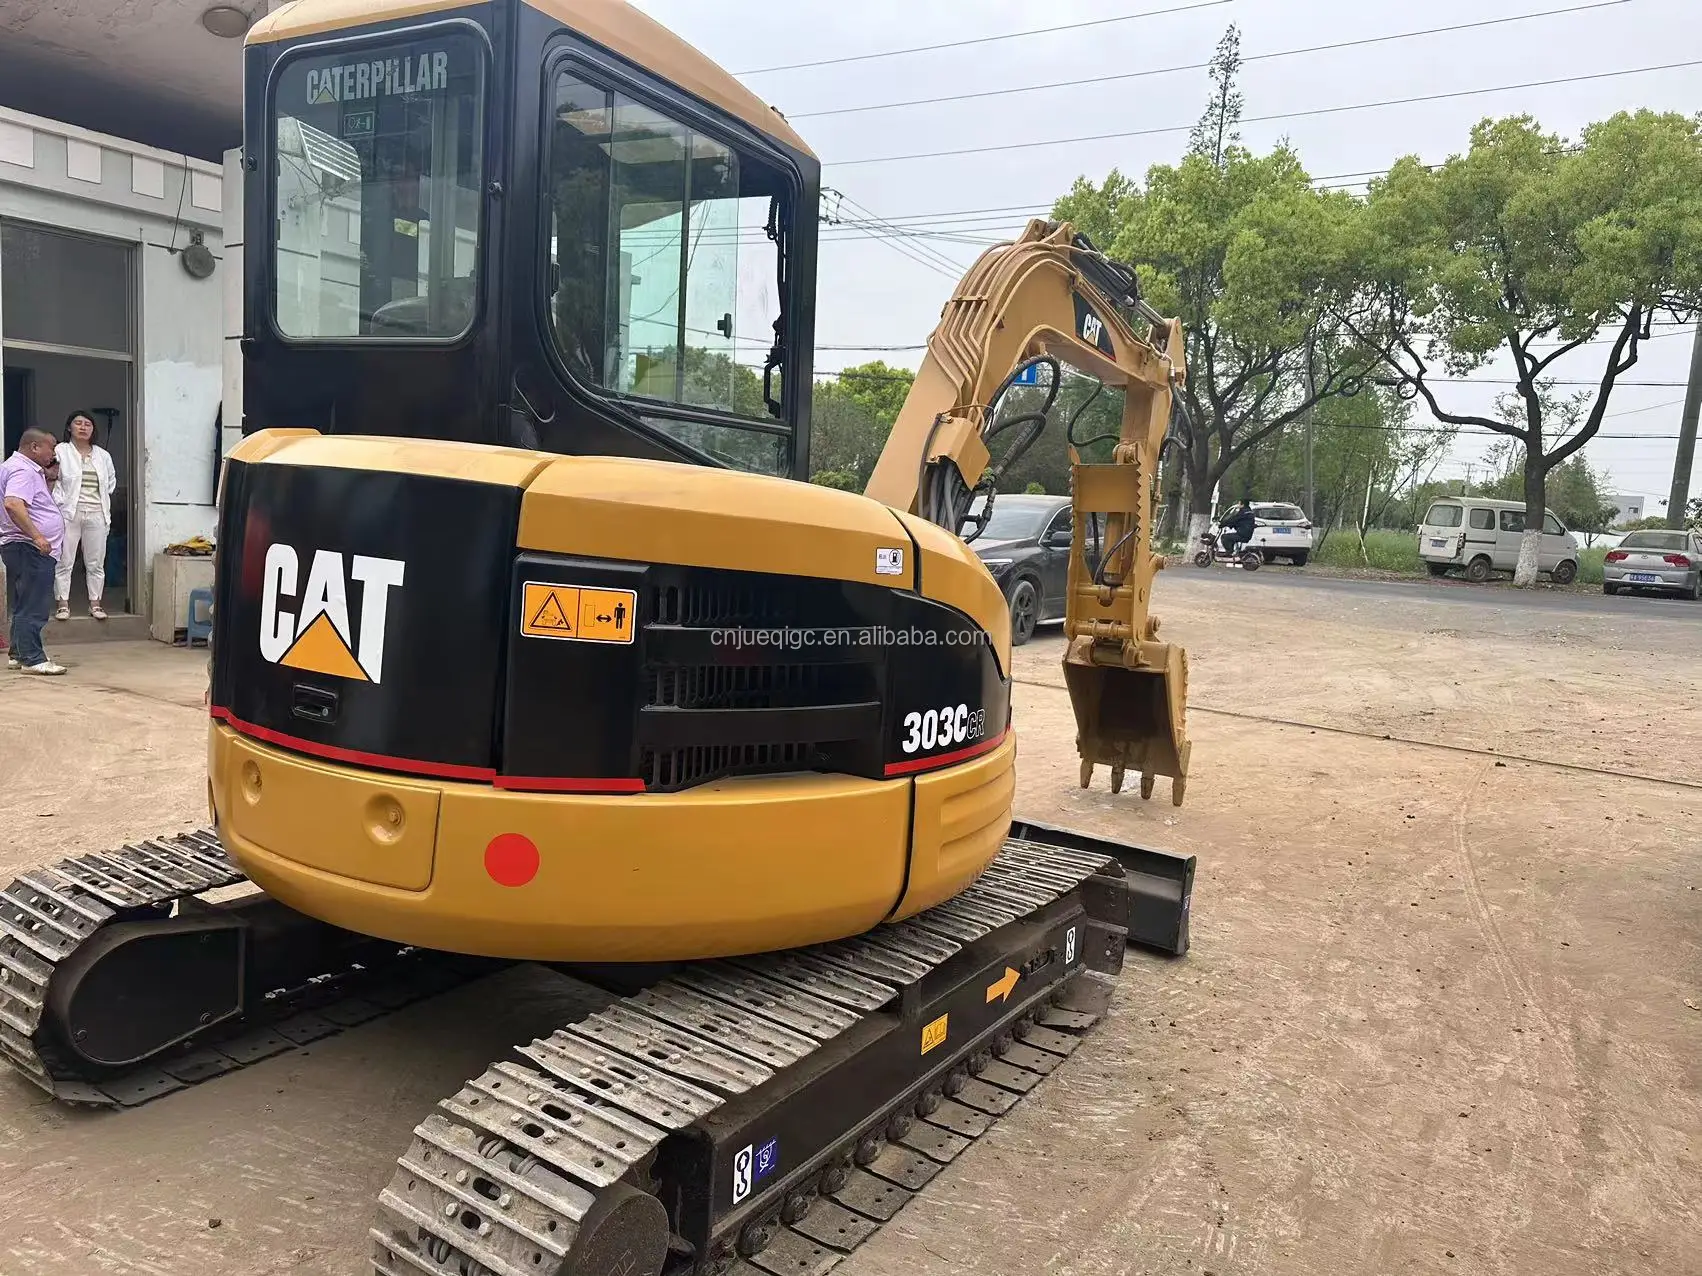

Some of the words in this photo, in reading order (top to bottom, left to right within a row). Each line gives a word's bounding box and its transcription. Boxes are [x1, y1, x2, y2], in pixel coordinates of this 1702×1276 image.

[306, 51, 448, 105] CATERPILLAR
[1083, 313, 1102, 347] CAT
[259, 543, 406, 685] CAT
